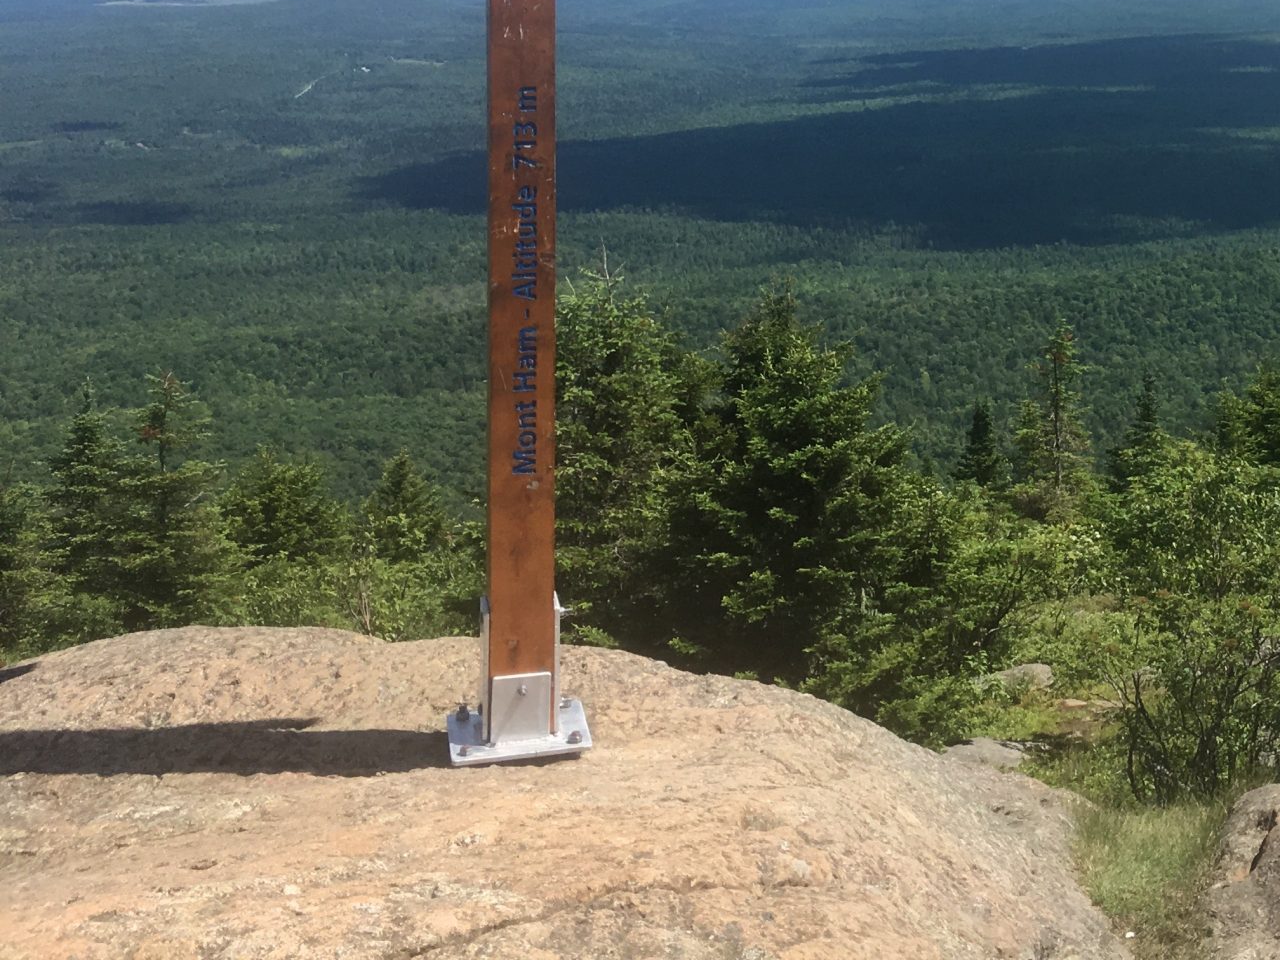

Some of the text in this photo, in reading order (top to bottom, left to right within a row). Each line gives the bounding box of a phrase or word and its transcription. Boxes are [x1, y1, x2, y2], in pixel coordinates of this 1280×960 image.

[517, 86, 538, 113] m
[511, 119, 540, 171] 713
[511, 184, 538, 301] Altitude
[511, 326, 538, 393] Ham
[511, 400, 539, 475] Mont
